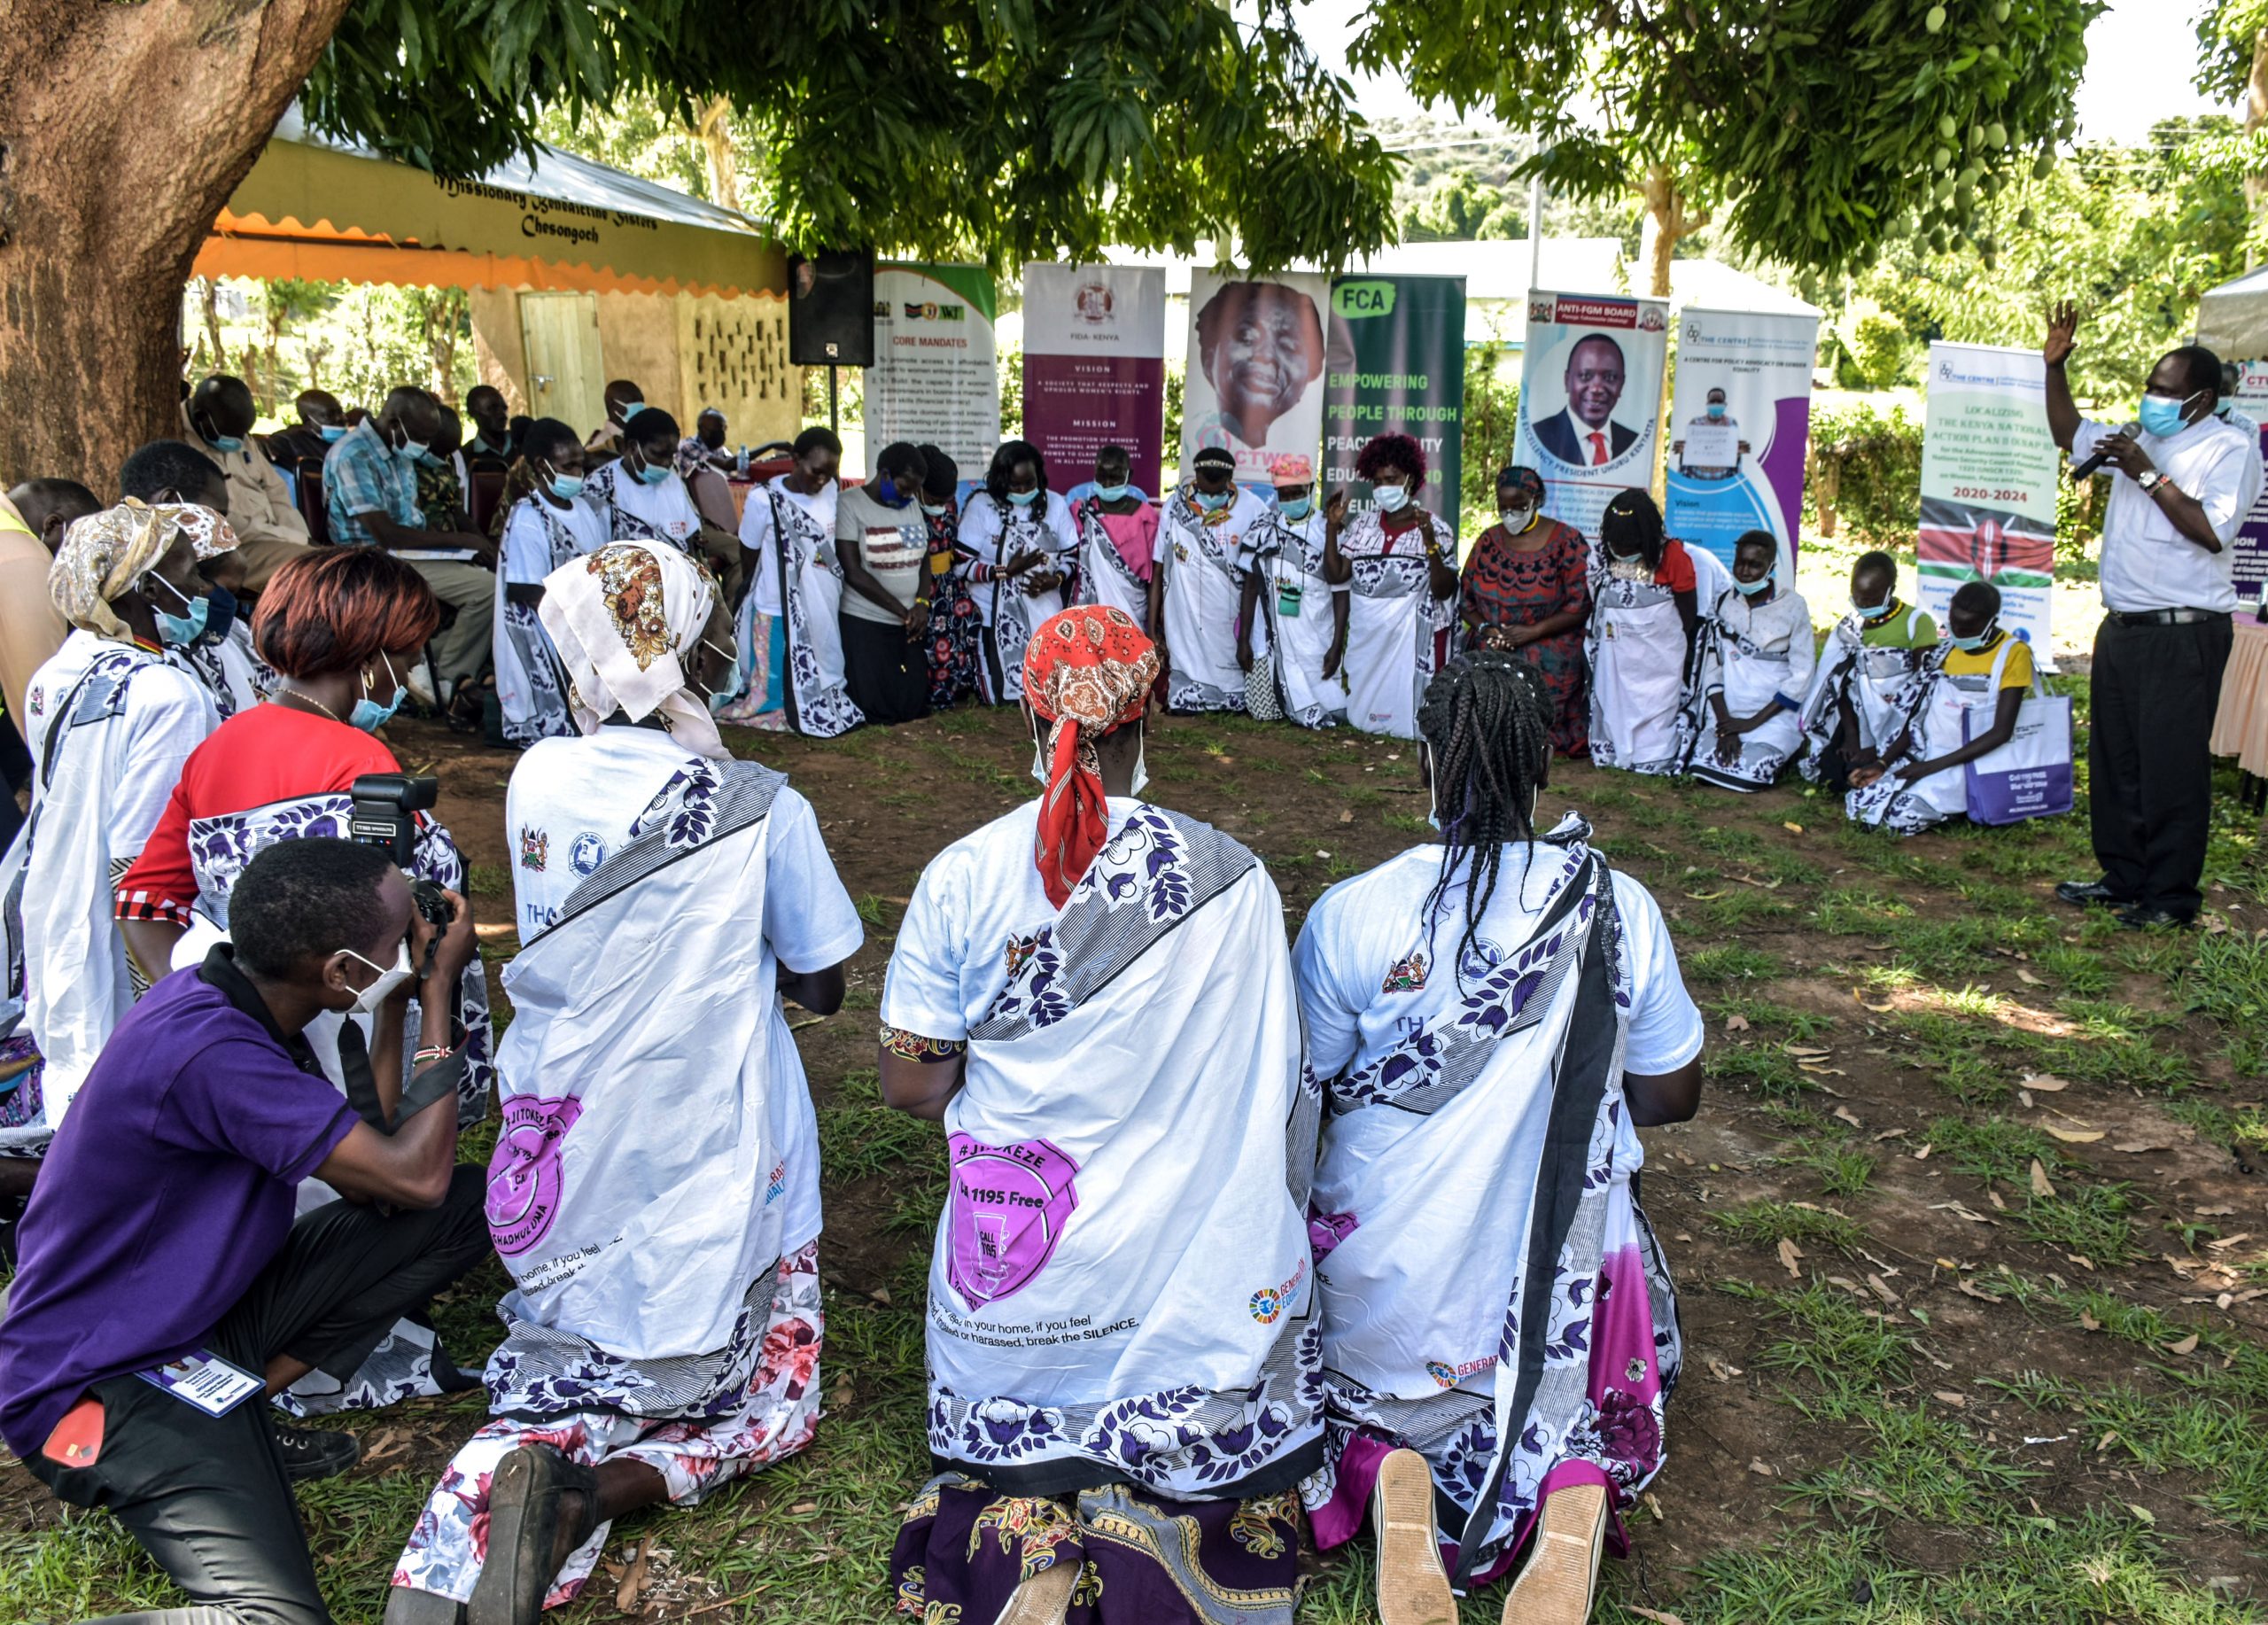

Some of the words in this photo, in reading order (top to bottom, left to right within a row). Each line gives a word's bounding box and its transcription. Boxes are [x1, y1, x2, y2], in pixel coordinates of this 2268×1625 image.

[522, 214, 599, 244] Chesongoch
[1343, 289, 1385, 310] FCA
[1557, 303, 1603, 315] ANTI-FGM
[1604, 307, 1635, 318] BOARD
[893, 337, 917, 346] CORE
[919, 338, 967, 348] MANDATES
[1329, 373, 1428, 390] EMPOWERING
[1328, 405, 1383, 420] PEOPLE
[1386, 406, 1457, 422] THROUGH
[1965, 406, 2023, 418] LOCALIZING
[1961, 419, 1994, 431] KENYA
[1998, 422, 2050, 437] NATIONAL
[1931, 432, 1970, 442] ACTION
[1972, 435, 2000, 446] PLAN
[1521, 421, 1553, 466] EXCELLENCY
[1554, 463, 1599, 478] PRESIDENT
[1601, 457, 1630, 474] UHURU
[1630, 418, 1656, 459] KENYATTA
[1952, 486, 2027, 502] 2020-2024
[1675, 499, 1699, 508] Vision
[971, 1188, 1006, 1205] 1195
[1008, 1191, 1045, 1209] Free
[979, 1231, 995, 1244] CALL
[561, 1251, 581, 1268] you
[580, 1243, 602, 1258] feel
[982, 1242, 997, 1259] 1195
[960, 1332, 969, 1341] or
[971, 1332, 1024, 1349] harassed,
[1025, 1336, 1060, 1347] break
[1061, 1332, 1080, 1342] the
[1083, 1317, 1140, 1340] SILENCE.
[964, 1319, 973, 1328] in
[975, 1321, 996, 1333] your
[998, 1323, 1034, 1334] home,
[1045, 1321, 1067, 1333] you
[1069, 1315, 1091, 1327] feel
[1457, 1354, 1499, 1376] GENERAT
